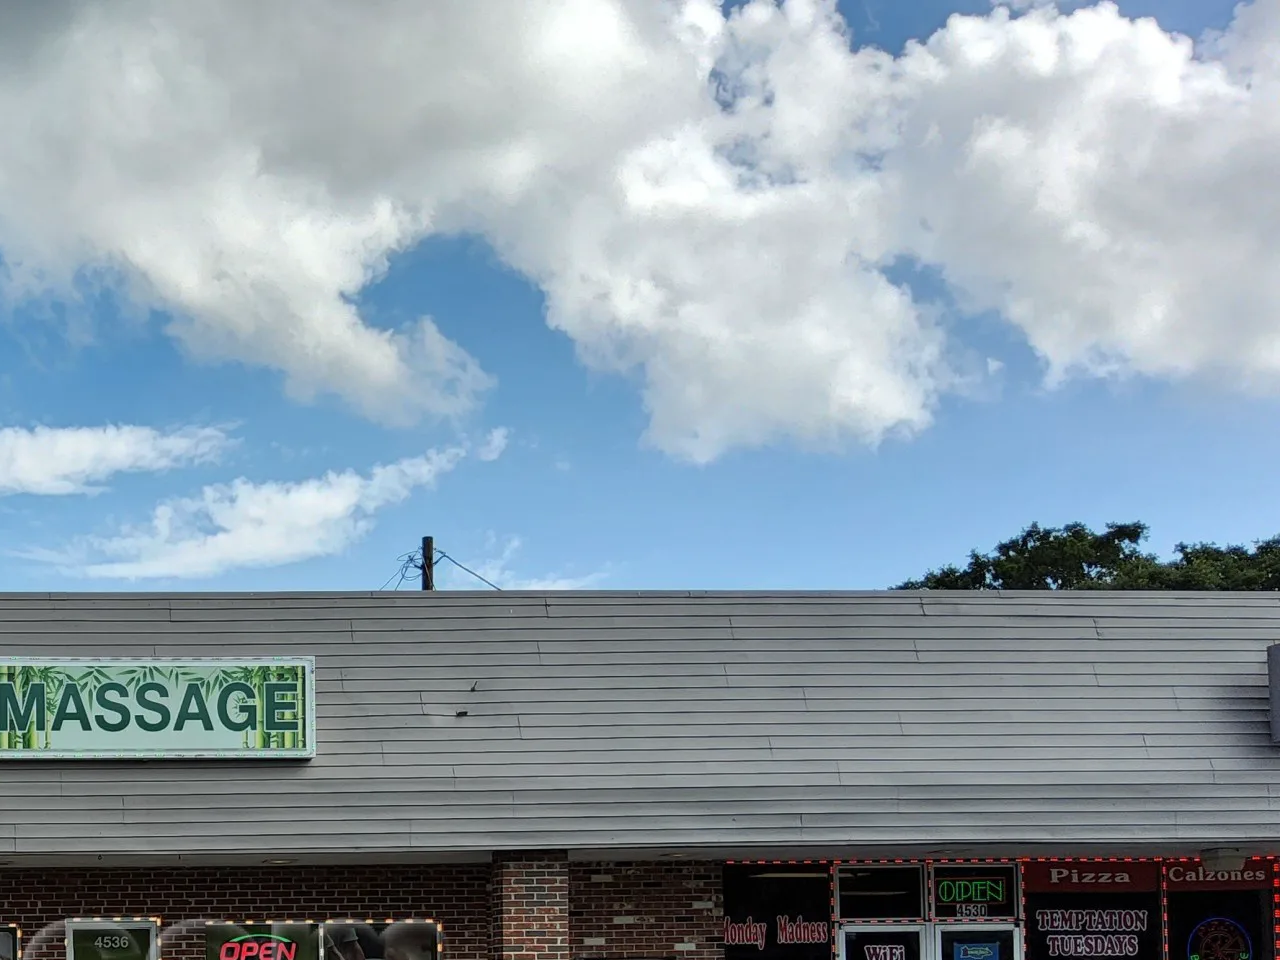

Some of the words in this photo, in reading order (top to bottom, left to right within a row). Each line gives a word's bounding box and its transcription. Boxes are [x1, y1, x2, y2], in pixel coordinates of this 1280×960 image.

[1049, 868, 1131, 883] Pizza
[1168, 866, 1266, 881] Calzones
[938, 879, 1005, 902] OPEN
[956, 904, 988, 918] 4530
[777, 915, 828, 944] Madness
[1036, 910, 1148, 931] TEMPTATION
[94, 936, 129, 948] 4536
[1047, 934, 1138, 956] TUESDAYS
